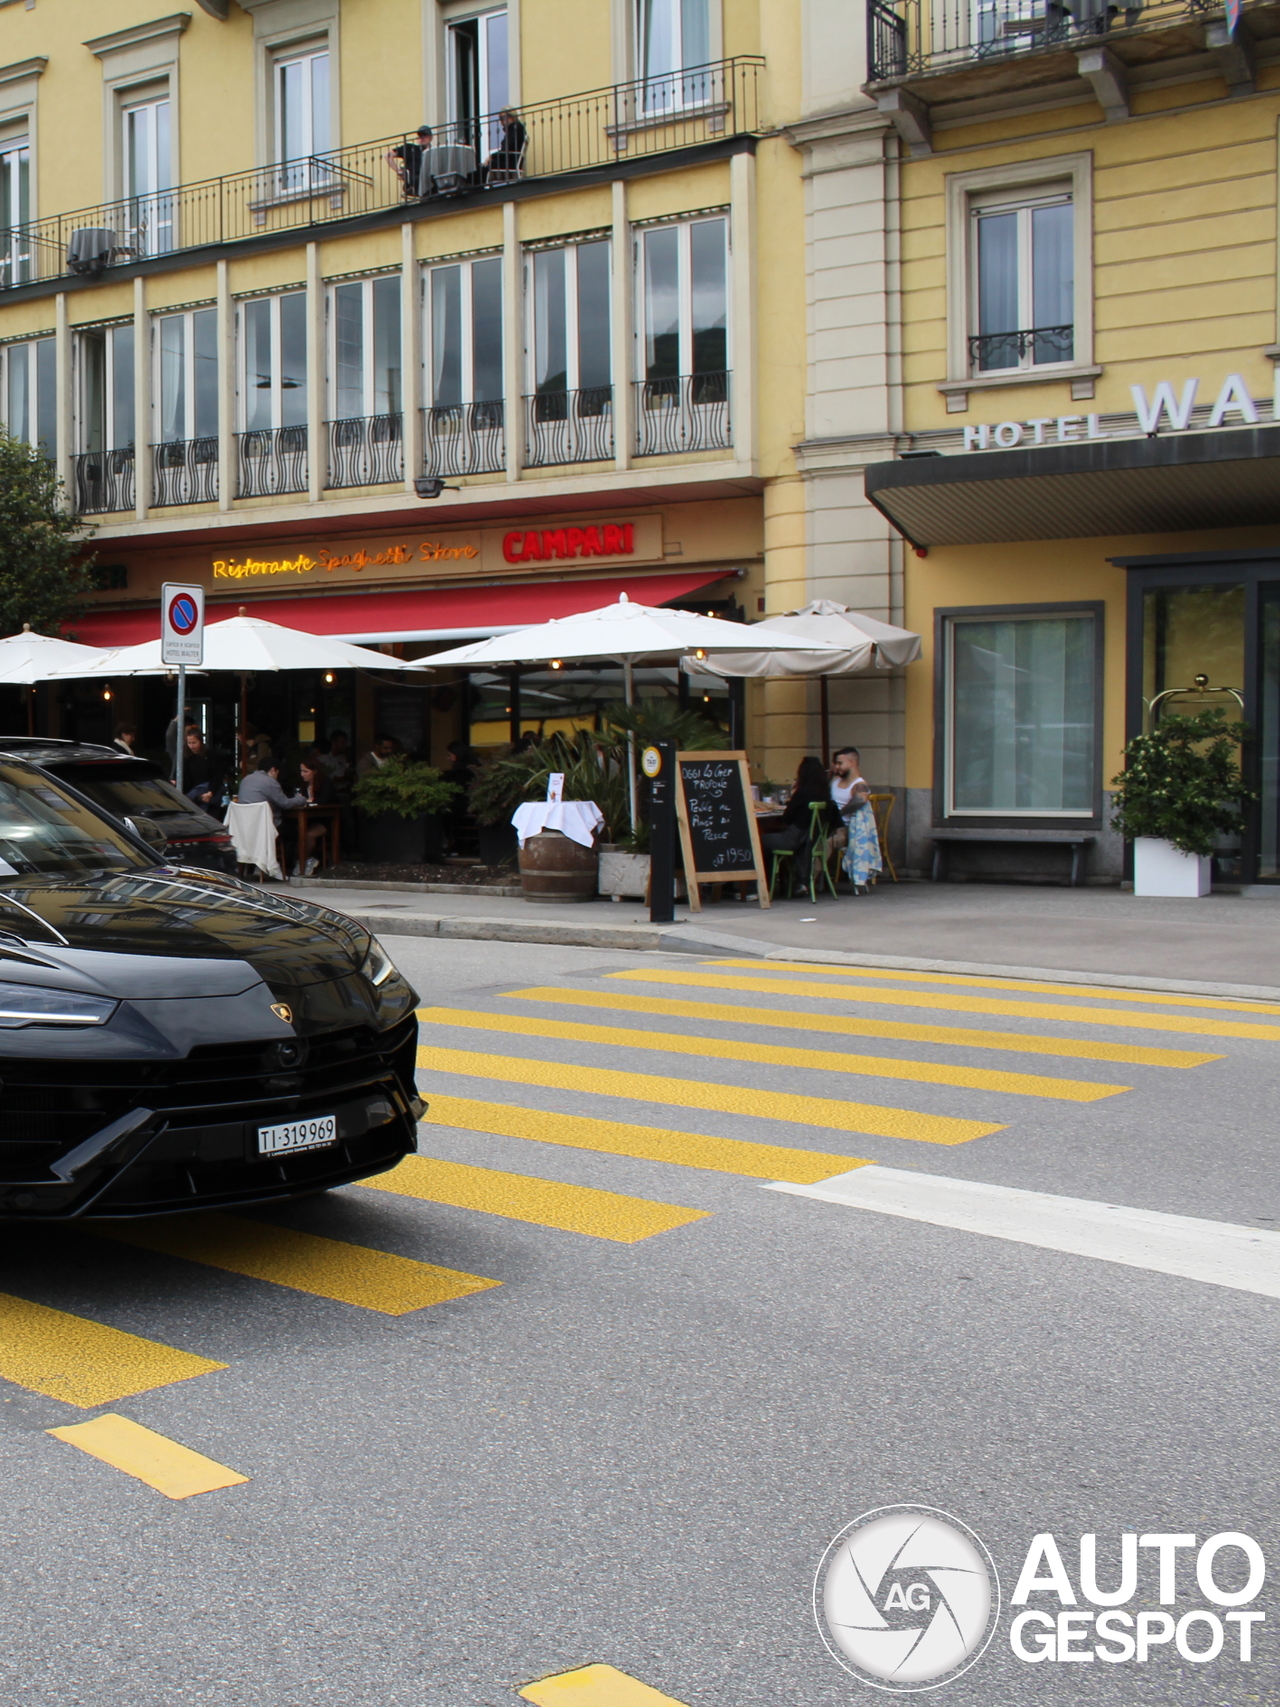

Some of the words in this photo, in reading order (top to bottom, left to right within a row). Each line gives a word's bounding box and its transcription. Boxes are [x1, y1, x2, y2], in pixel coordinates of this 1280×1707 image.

[964, 413, 1109, 450] HOTEL
[1130, 368, 1280, 433] WA
[212, 554, 317, 578] Ristorante
[317, 544, 413, 571] Spaghetti
[420, 542, 478, 561] Store
[503, 523, 634, 563] CAMPARI
[682, 767, 701, 779] OGGI
